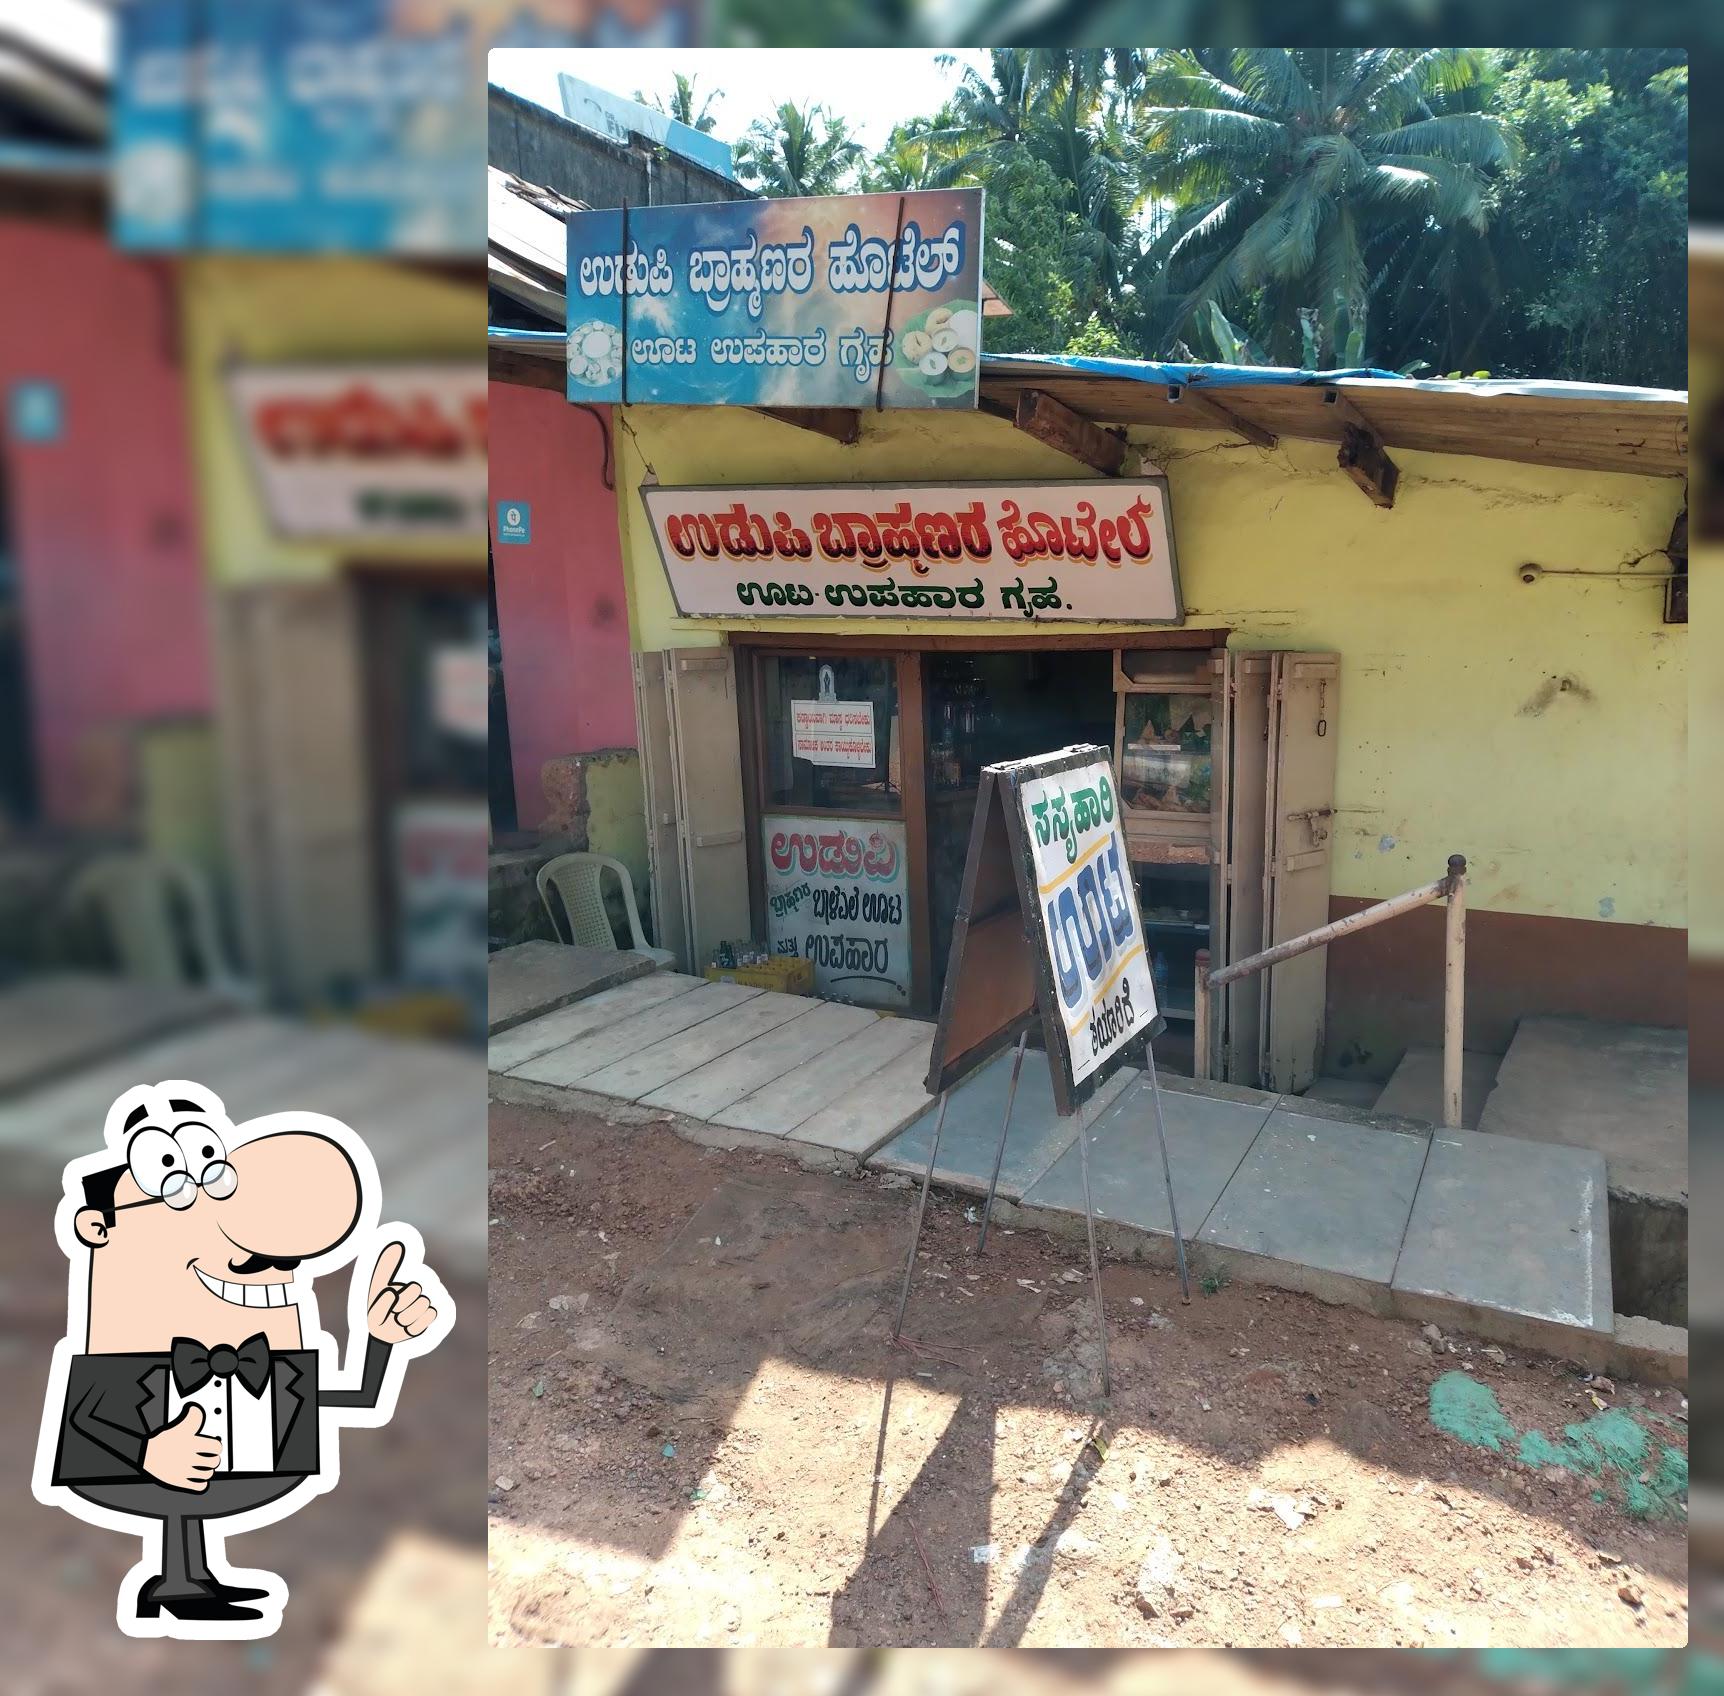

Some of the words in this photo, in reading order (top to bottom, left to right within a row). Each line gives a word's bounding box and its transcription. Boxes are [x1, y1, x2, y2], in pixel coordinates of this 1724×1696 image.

[579, 239, 674, 296] ಉಡುಪಿ
[689, 232, 813, 318] ಬ್ರಾಹ್ಮಣರ
[829, 226, 963, 291] ಹೊಟೆಲ್
[631, 336, 698, 365] ಊಟ
[709, 327, 827, 366] ಉಪಹಾರ
[839, 326, 895, 384] ಗೃಹ
[665, 502, 814, 562] ಉಡುಪಿ
[812, 501, 993, 578] ಬ್ರಾಹ್ಮಣರ
[996, 493, 1154, 569] ಹೊಟೇಲ್
[824, 577, 985, 609] ಉಪಹಾರ
[1031, 775, 1114, 865] ಸಸ್ಯಹಾರಿ
[770, 827, 901, 884] ಉಡುಪಿ
[862, 892, 903, 926] ಊಟ
[1047, 831, 1134, 1009] ಊಟ
[805, 933, 889, 974] ಉಪಹಾರ
